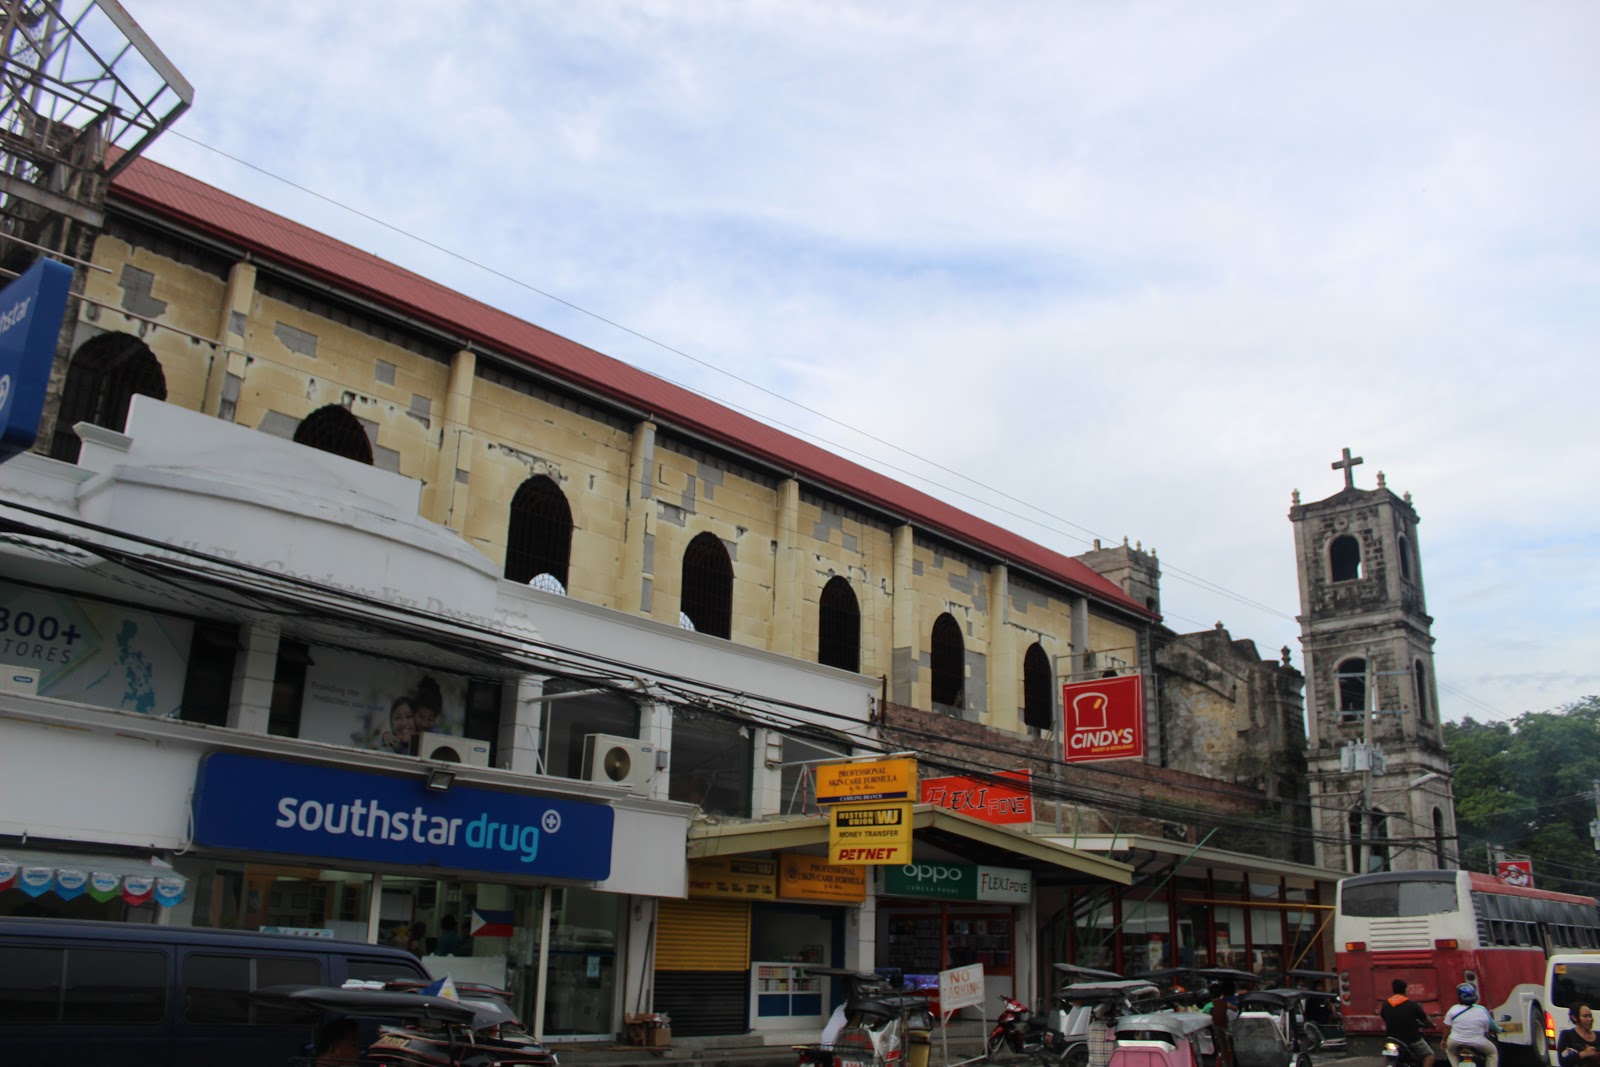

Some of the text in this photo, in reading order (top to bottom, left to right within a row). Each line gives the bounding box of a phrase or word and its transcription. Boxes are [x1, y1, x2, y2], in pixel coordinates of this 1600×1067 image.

[838, 767, 888, 779] PROFESSIONAL
[845, 777, 862, 787] CARE
[863, 775, 898, 785] FORMULA
[863, 793, 883, 801] BRANCH
[838, 811, 874, 820] WESTERN
[876, 809, 899, 825] WU
[848, 818, 874, 826] UNION
[275, 797, 540, 863] southstar drug
[839, 829, 899, 839] MONEY TRANSFER
[838, 847, 898, 861] PETNET
[949, 970, 971, 986] NO
